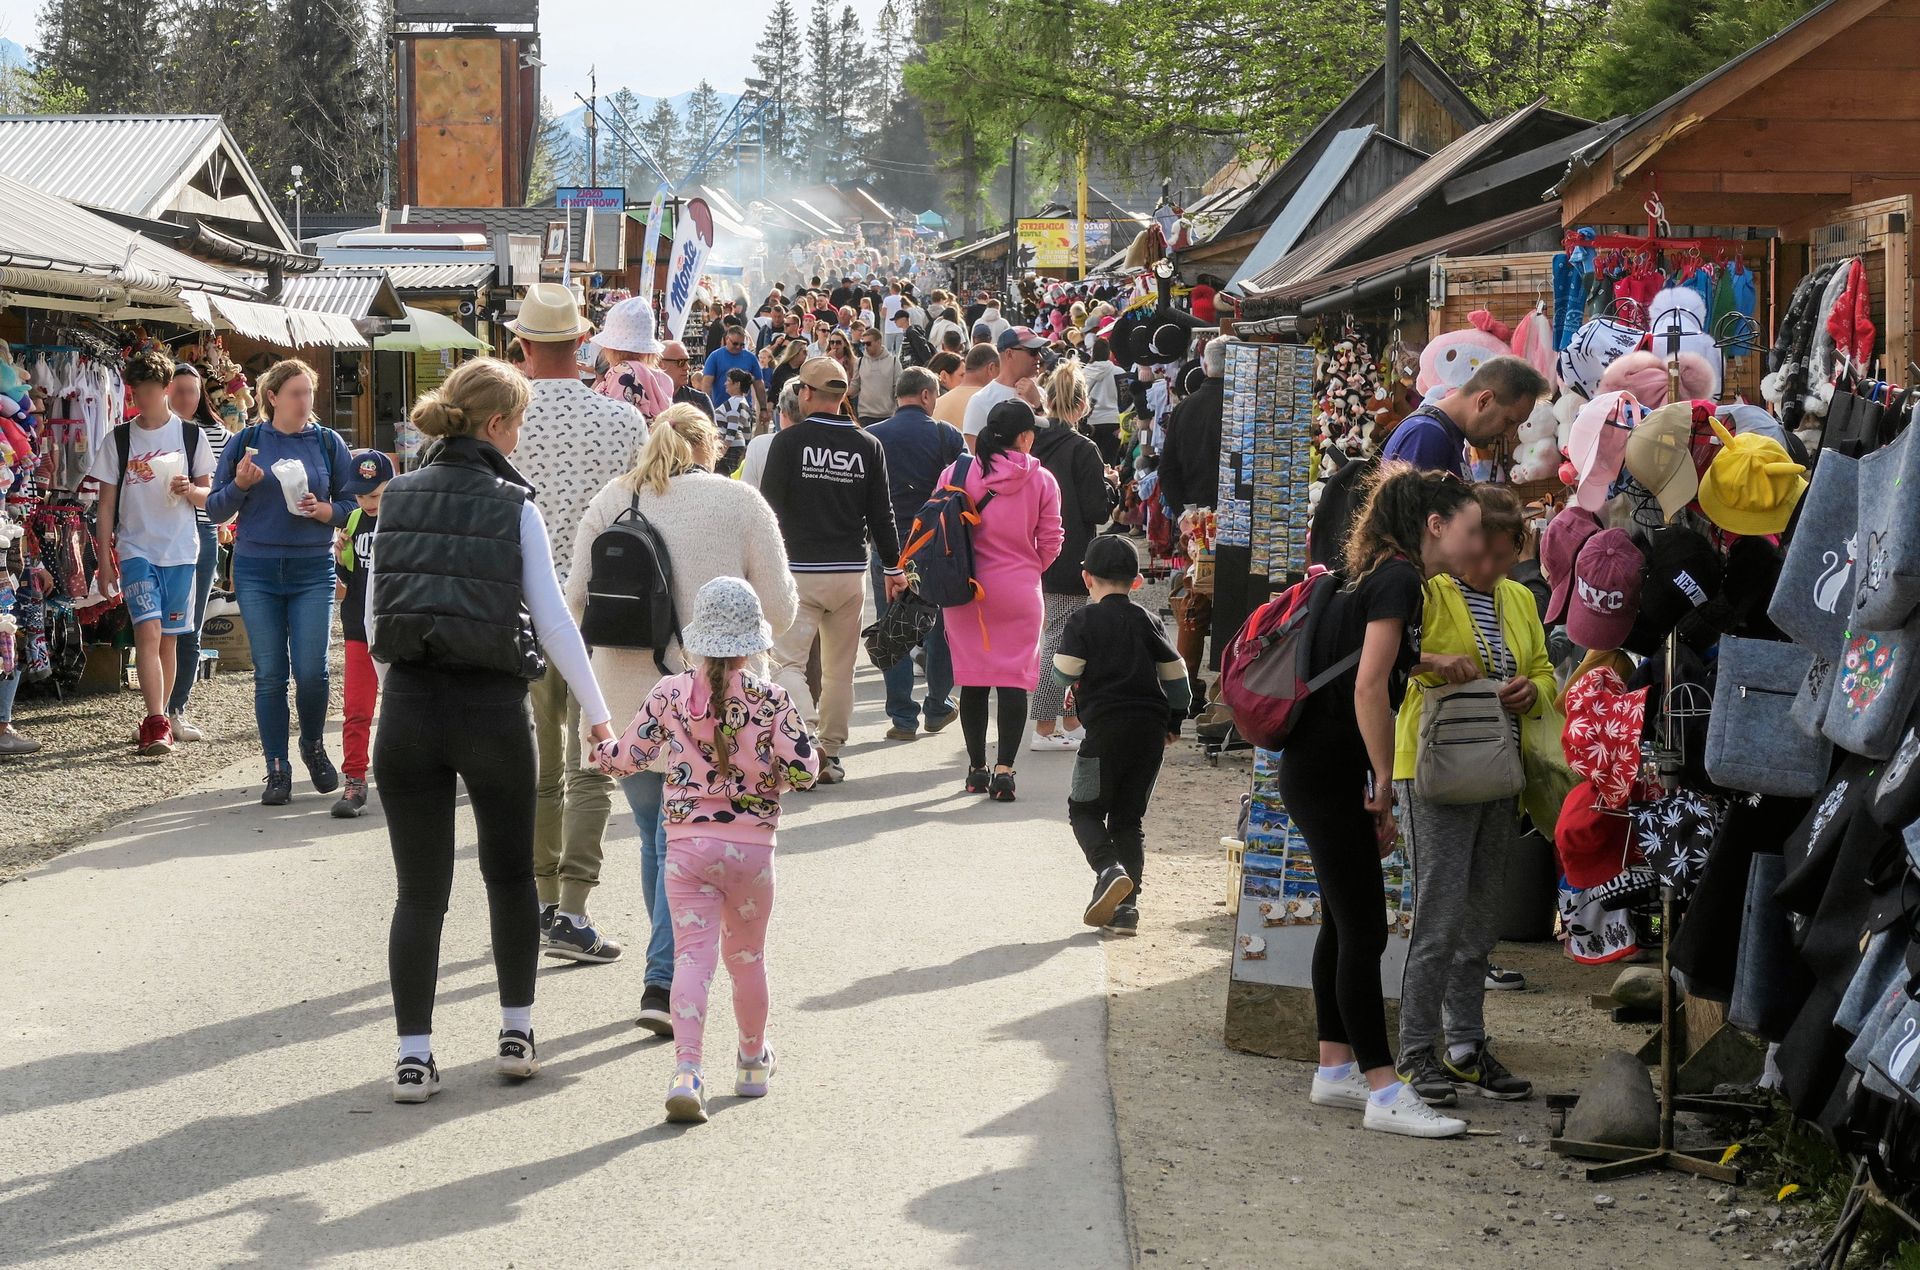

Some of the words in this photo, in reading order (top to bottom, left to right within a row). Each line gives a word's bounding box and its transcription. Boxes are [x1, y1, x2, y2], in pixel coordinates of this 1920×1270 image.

[561, 198, 619, 207] PONTONOWY
[576, 189, 603, 198] ZJAZD
[671, 240, 697, 314] Monte
[802, 446, 865, 473] NASA
[1577, 576, 1623, 610] NYC
[1673, 570, 1698, 596] NEW
[136, 592, 155, 611] 92
[505, 1044, 520, 1052] AIR
